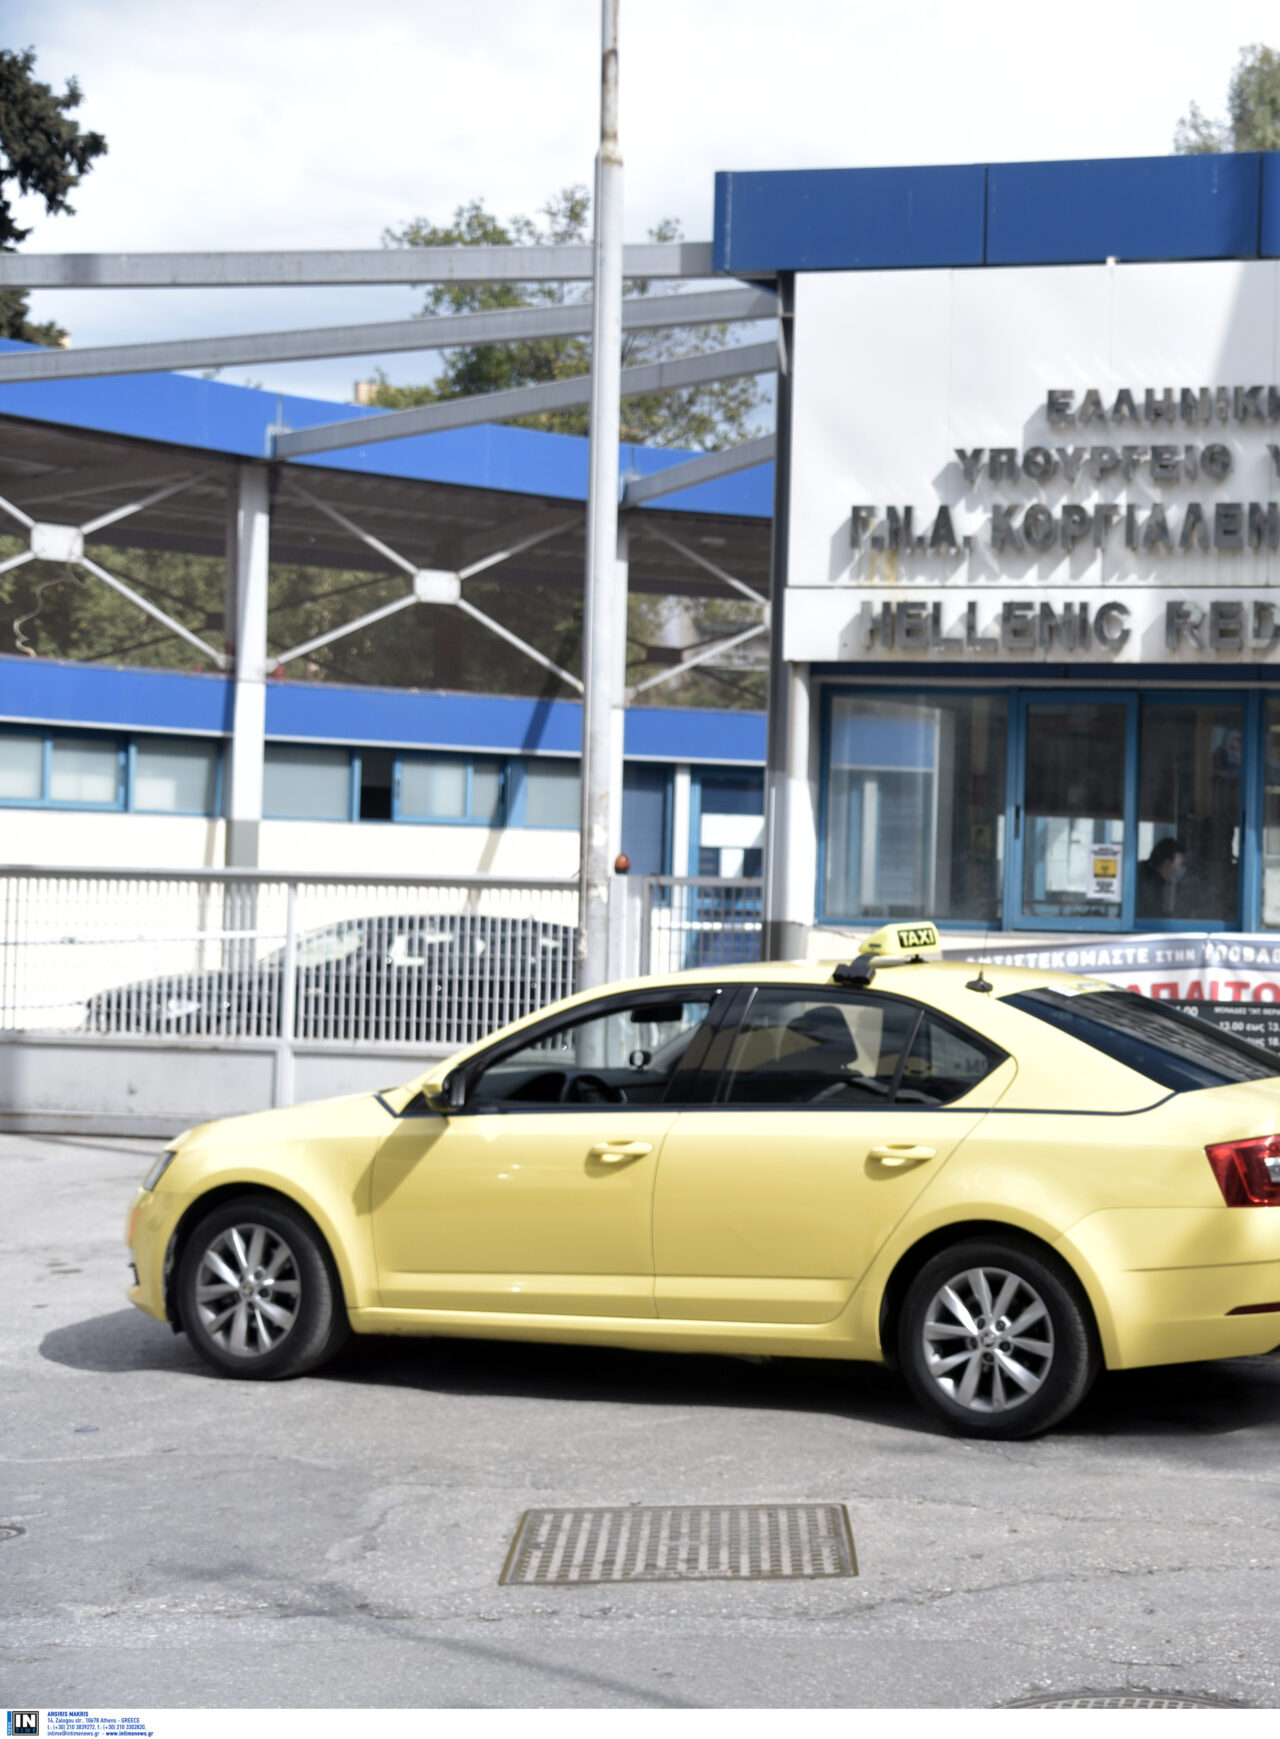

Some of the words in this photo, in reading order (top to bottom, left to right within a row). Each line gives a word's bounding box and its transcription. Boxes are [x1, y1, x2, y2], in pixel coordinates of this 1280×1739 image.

[955, 442, 1234, 482] ΥΠΟΥΡΓΕΙΟ
[861, 601, 1130, 650] HELLENIC
[900, 929, 935, 947] TAXI
